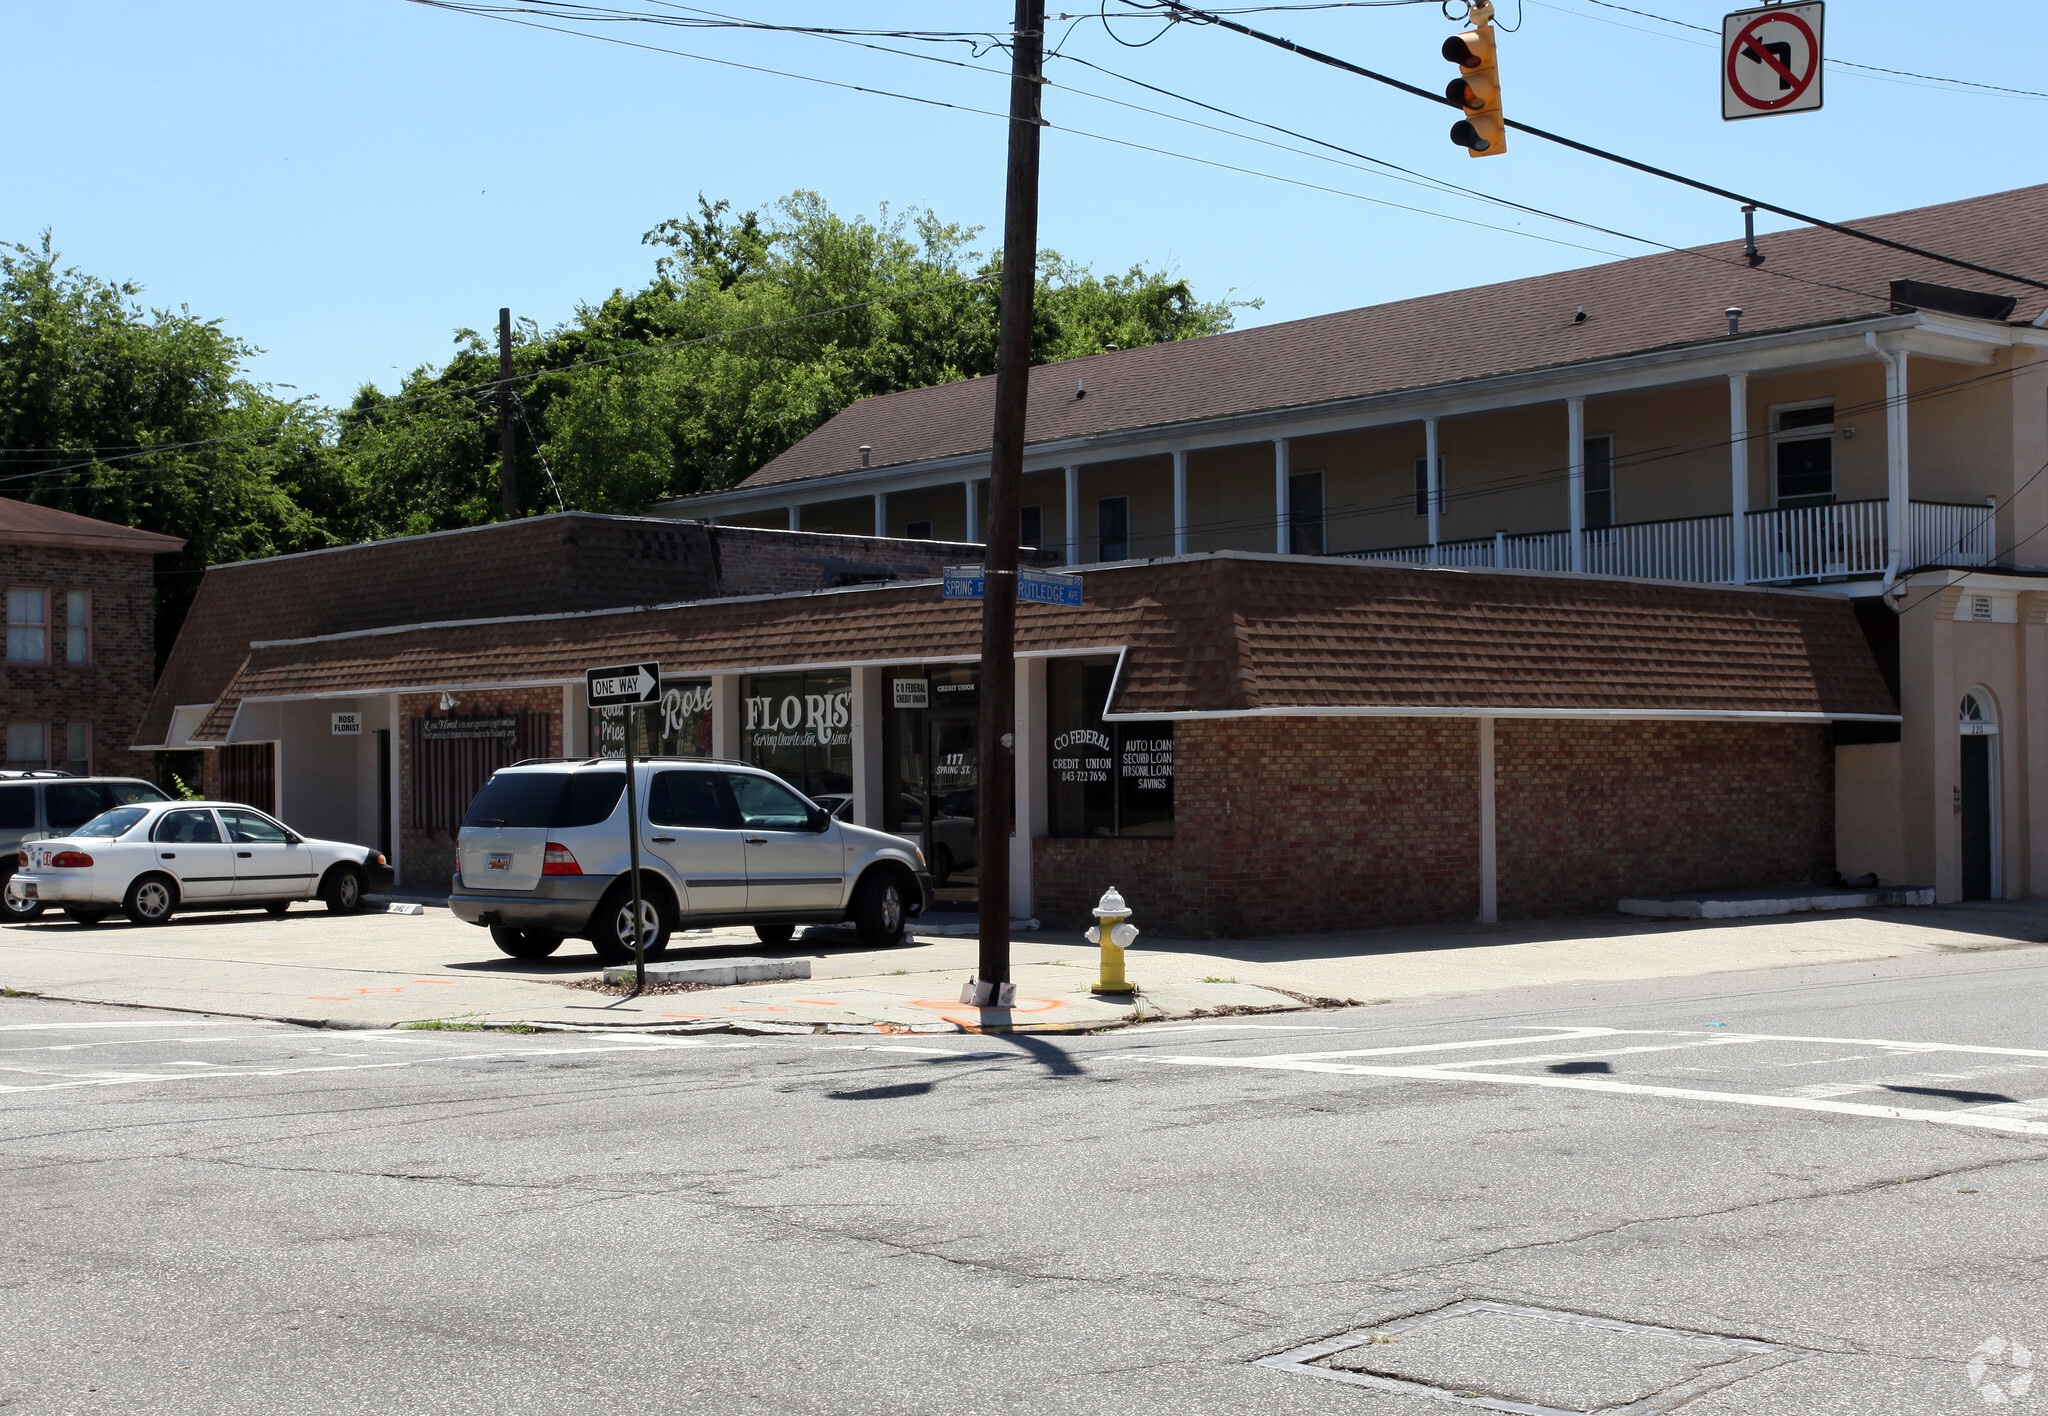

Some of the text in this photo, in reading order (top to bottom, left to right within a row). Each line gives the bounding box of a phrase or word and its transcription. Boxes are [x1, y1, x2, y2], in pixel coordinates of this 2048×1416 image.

[946, 580, 972, 595] SPRING
[1018, 582, 1079, 602] RUTLEDGE AVE
[595, 677, 638, 695] ONE WAY
[906, 683, 926, 693] FEDERAL
[896, 694, 926, 703] CREDIT UNION
[661, 685, 712, 740] Rose
[338, 715, 355, 723] ROSE
[601, 721, 625, 740] Price
[1972, 725, 1984, 734] 220
[753, 732, 778, 754] Serving
[1070, 729, 1110, 751] FEDERAL
[1125, 740, 1148, 752] AUTO
[947, 753, 964, 765] 117
[1053, 758, 1112, 769] CREDIT UNION
[936, 765, 959, 775] SPRING
[1138, 778, 1166, 789] SAVINGS
